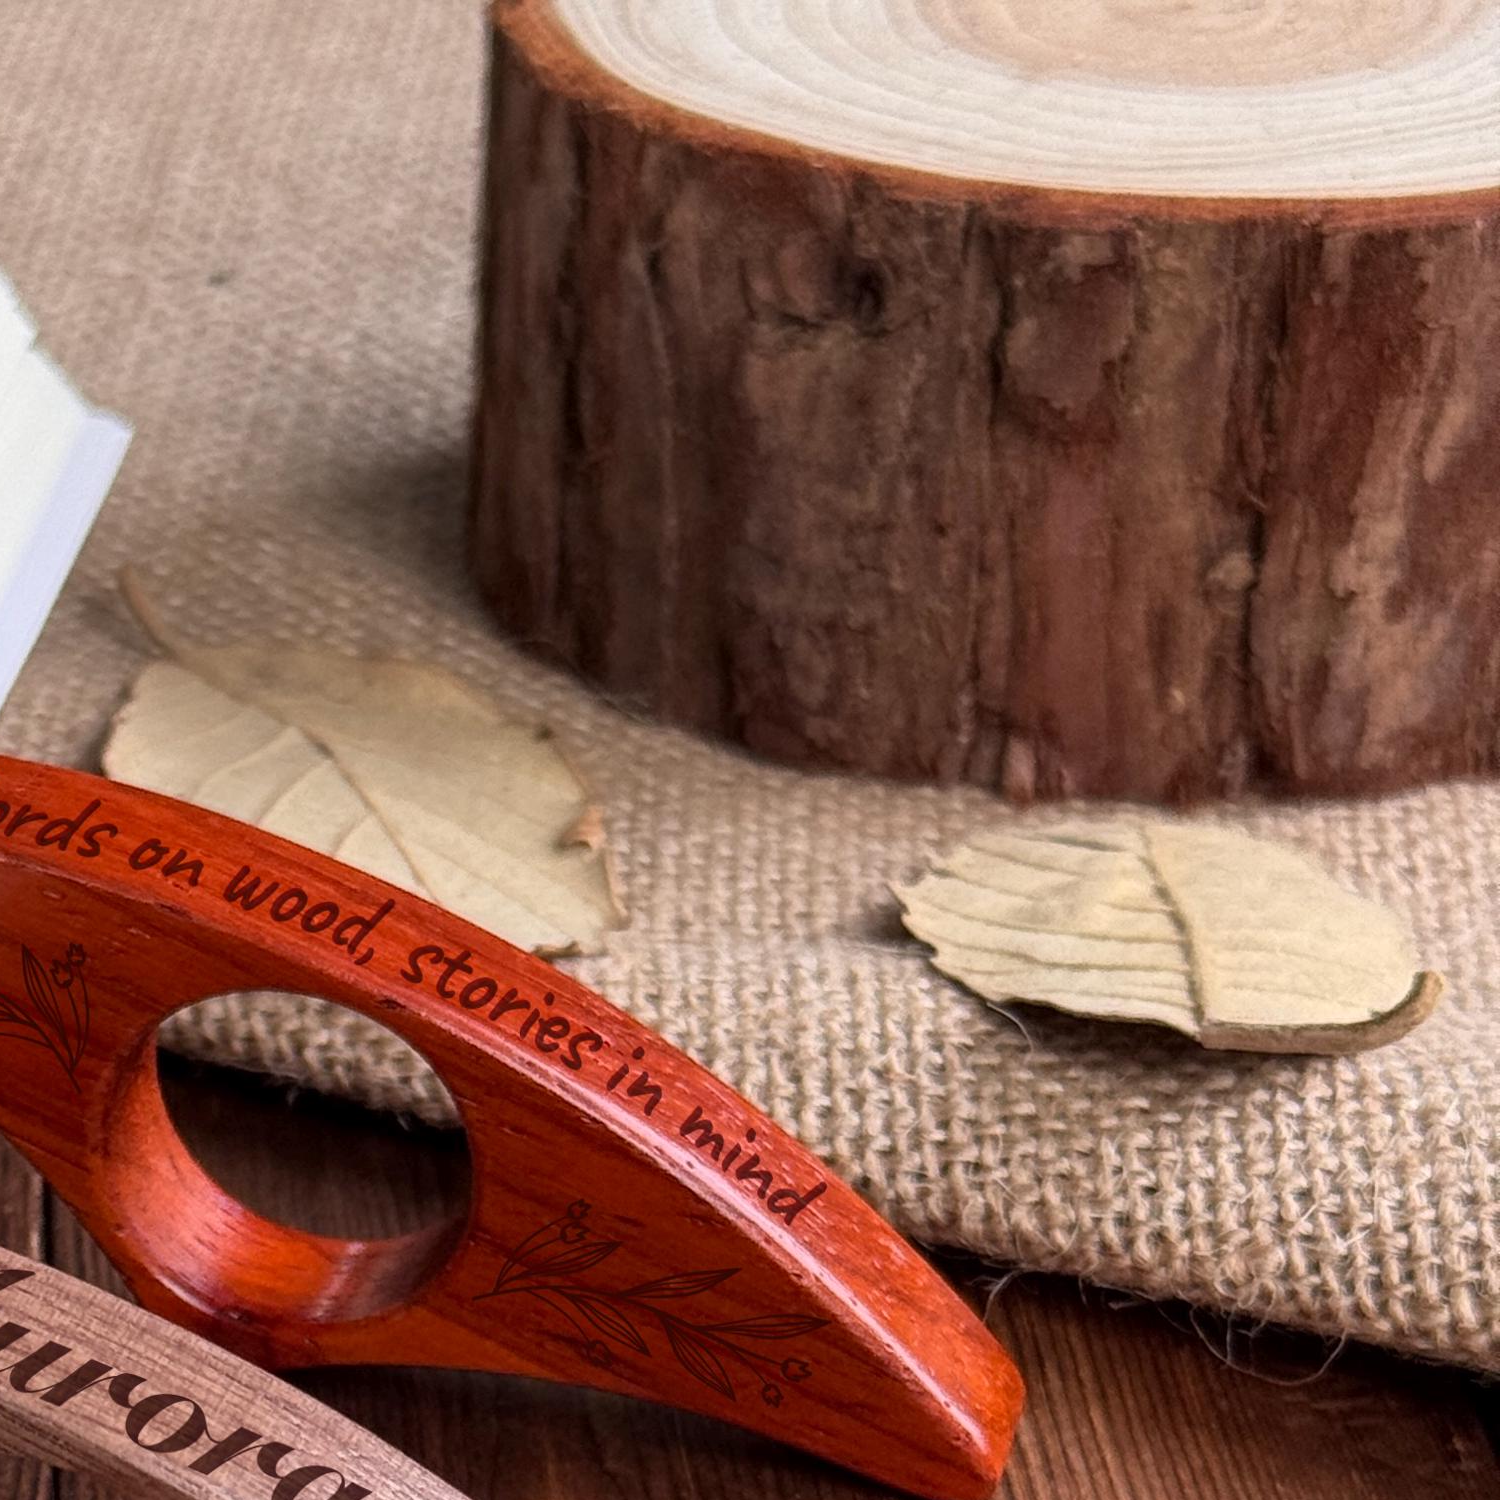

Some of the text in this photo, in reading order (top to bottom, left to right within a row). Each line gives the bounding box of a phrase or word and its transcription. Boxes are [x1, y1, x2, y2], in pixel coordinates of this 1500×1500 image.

[127, 837, 204, 889] on
[222, 863, 395, 965] wood,
[400, 943, 603, 1072] stories
[603, 1048, 663, 1117] in
[681, 1106, 827, 1228] mind
